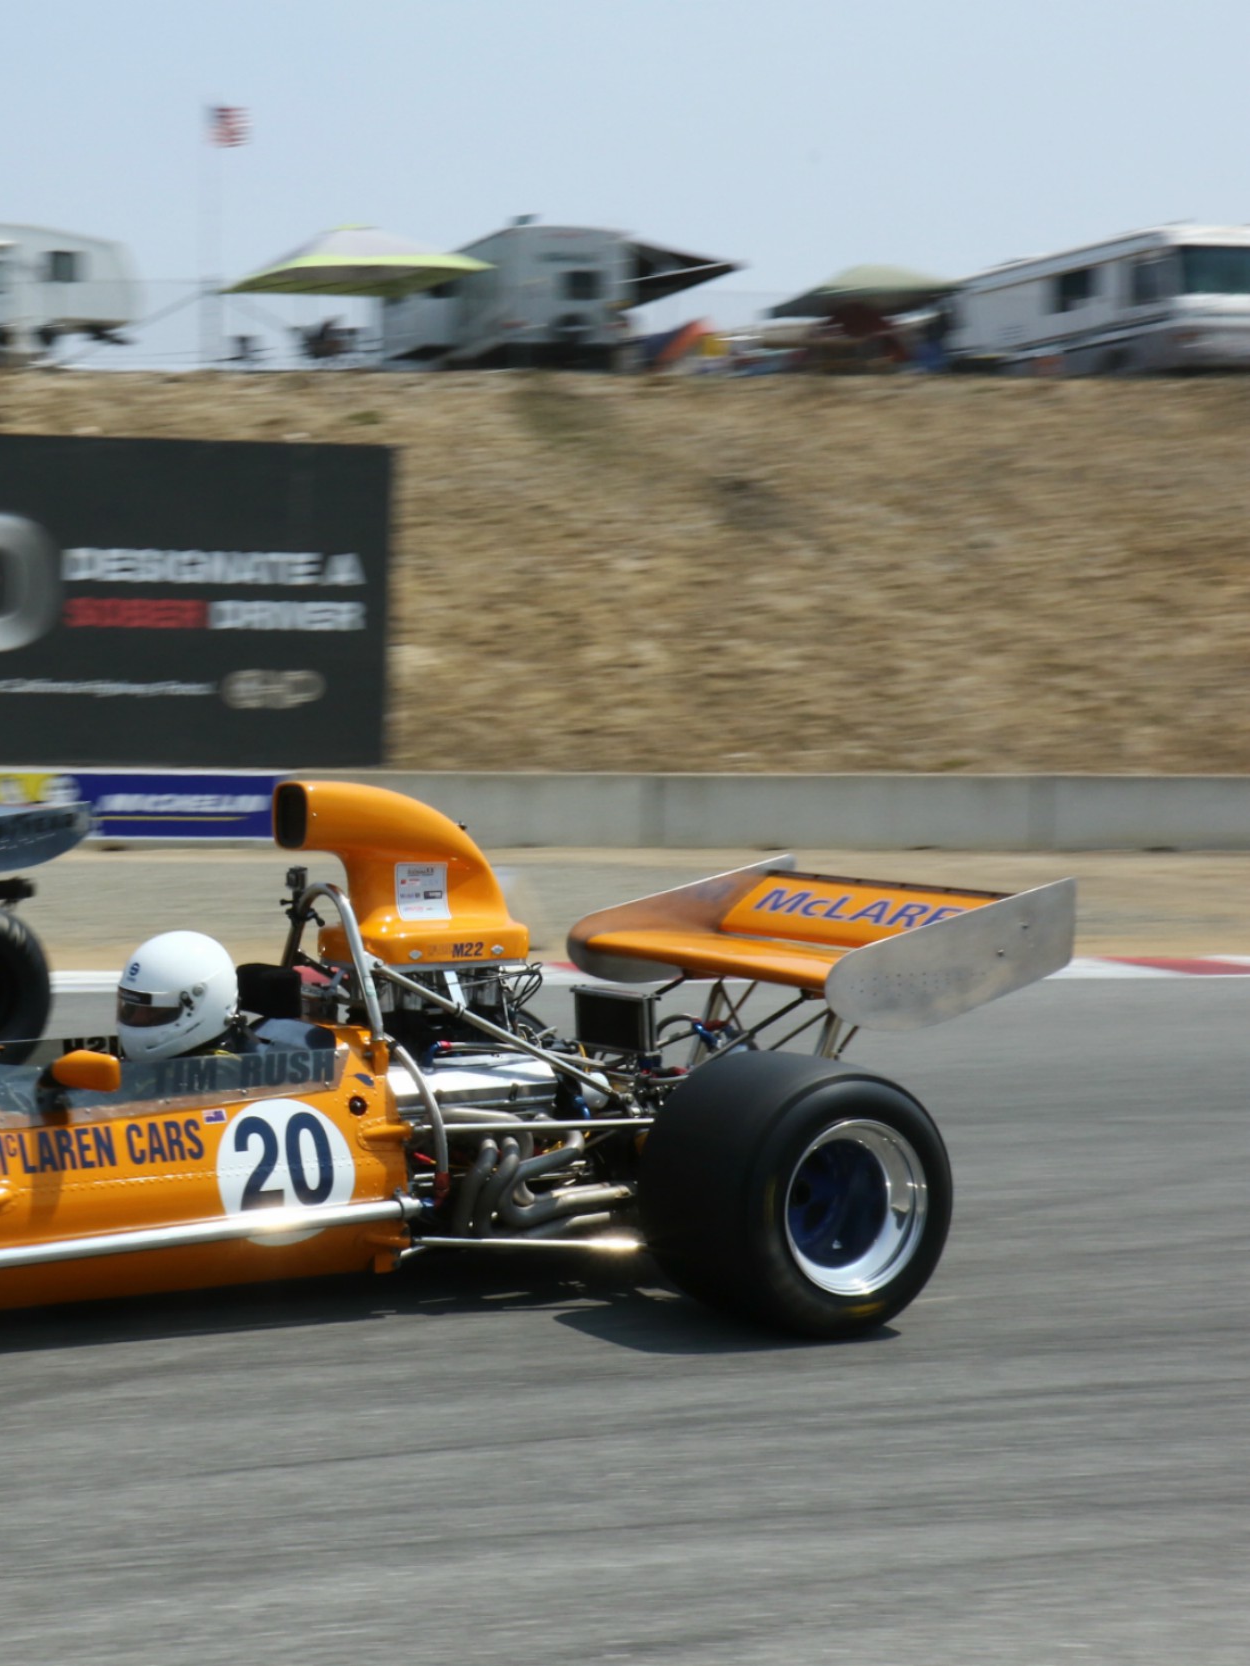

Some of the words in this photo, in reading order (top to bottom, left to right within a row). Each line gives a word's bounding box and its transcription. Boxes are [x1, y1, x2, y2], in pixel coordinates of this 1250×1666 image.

[61, 547, 323, 585] DESIGNATE
[322, 552, 367, 586] A
[208, 600, 367, 632] DRIVER
[452, 941, 484, 959] M22
[154, 1055, 218, 1095] TIM
[241, 1048, 335, 1088] RUSH
[126, 1119, 205, 1166] CARS
[234, 1112, 334, 1213] 20
